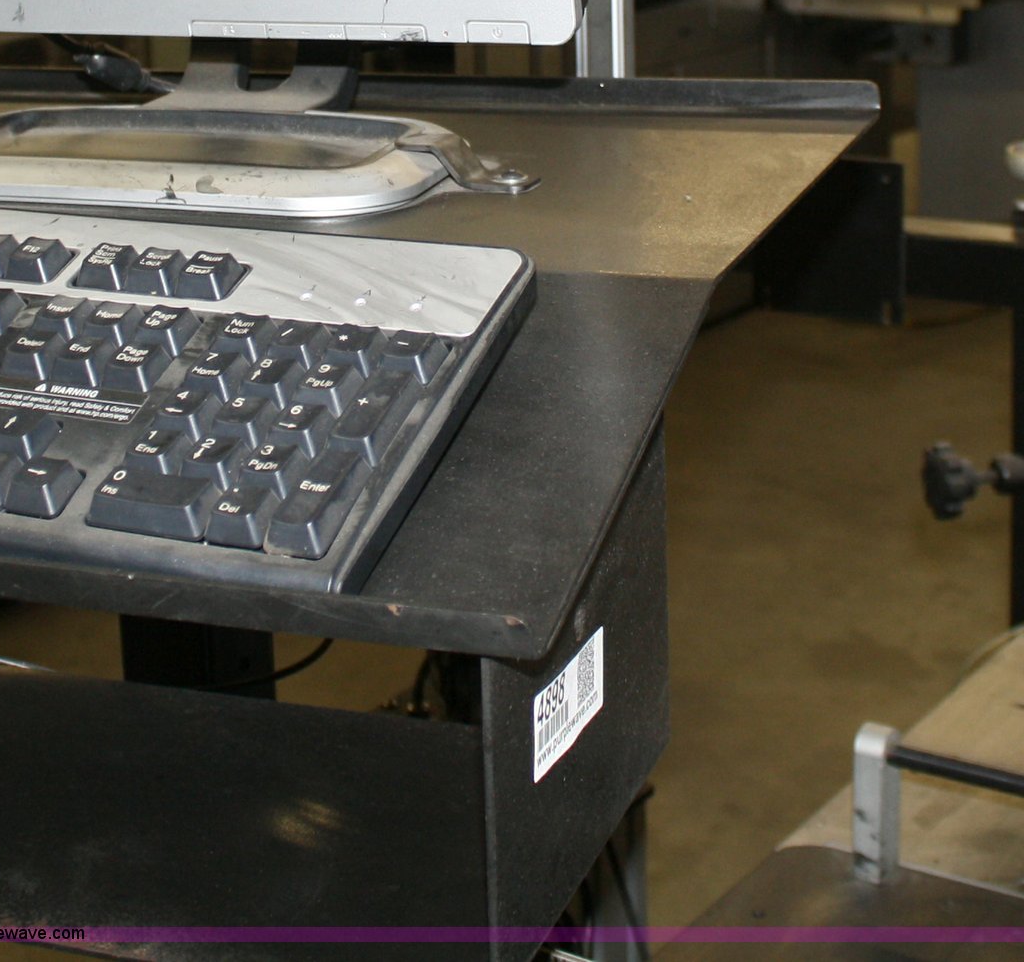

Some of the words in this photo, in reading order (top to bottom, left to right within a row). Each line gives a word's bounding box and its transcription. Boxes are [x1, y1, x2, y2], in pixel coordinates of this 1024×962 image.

[22, 244, 42, 254] F12
[139, 258, 162, 267] Lock
[197, 252, 224, 262] Pause
[46, 302, 74, 314] Insert
[95, 310, 124, 320] Home
[150, 310, 178, 322] Page
[144, 317, 160, 328] Up
[229, 318, 256, 328] Num
[224, 326, 250, 335] Lock
[68, 343, 92, 354] End
[122, 345, 150, 356] Page
[115, 352, 145, 364] Down
[206, 352, 220, 362] 7
[259, 358, 273, 368] 8
[192, 366, 220, 376] Home
[317, 364, 332, 374] 9
[305, 376, 334, 388] PgUp
[50, 384, 99, 398] WARNING
[176, 390, 190, 400] 4
[231, 398, 246, 408] 5
[290, 405, 304, 416] 6
[147, 430, 158, 440] 1
[134, 442, 159, 454] End
[200, 438, 216, 449] 2
[260, 445, 275, 456] 3
[248, 458, 278, 471] PgDn
[100, 484, 119, 495] Ins
[299, 480, 331, 493] Enter
[218, 502, 242, 514] Del
[538, 671, 566, 726] 4898
